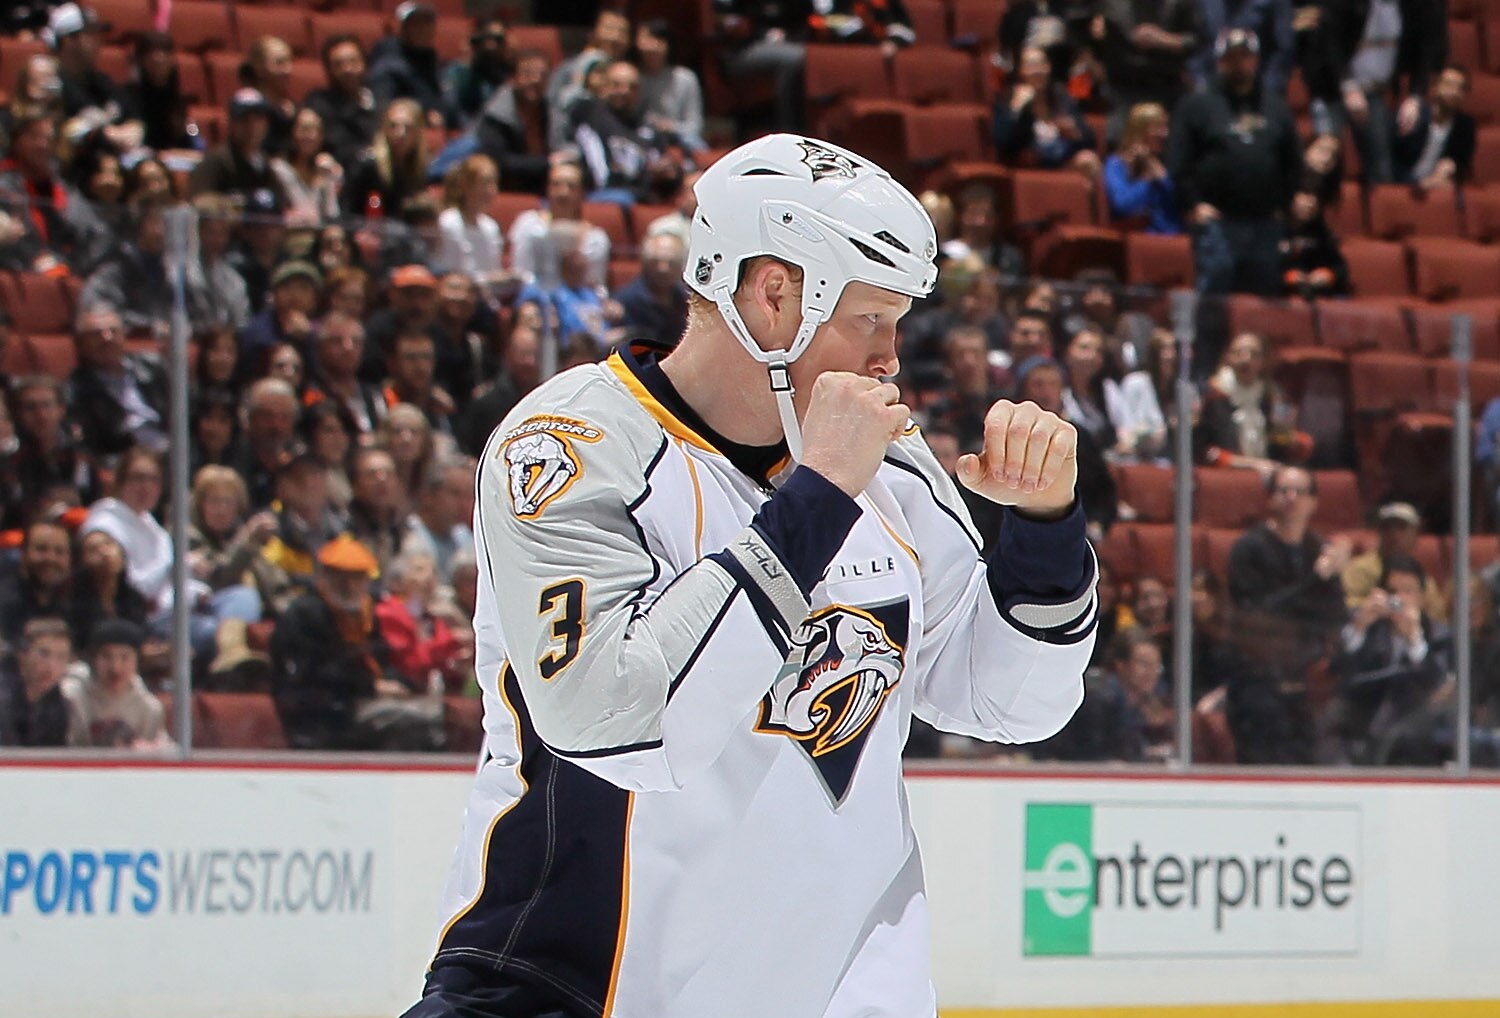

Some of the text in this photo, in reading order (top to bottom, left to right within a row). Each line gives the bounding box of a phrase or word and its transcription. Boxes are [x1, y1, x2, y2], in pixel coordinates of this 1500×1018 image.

[537, 577, 587, 681] 3
[0, 850, 373, 914] PORTSWEST.COM
[1026, 834, 1352, 931] enterprise
